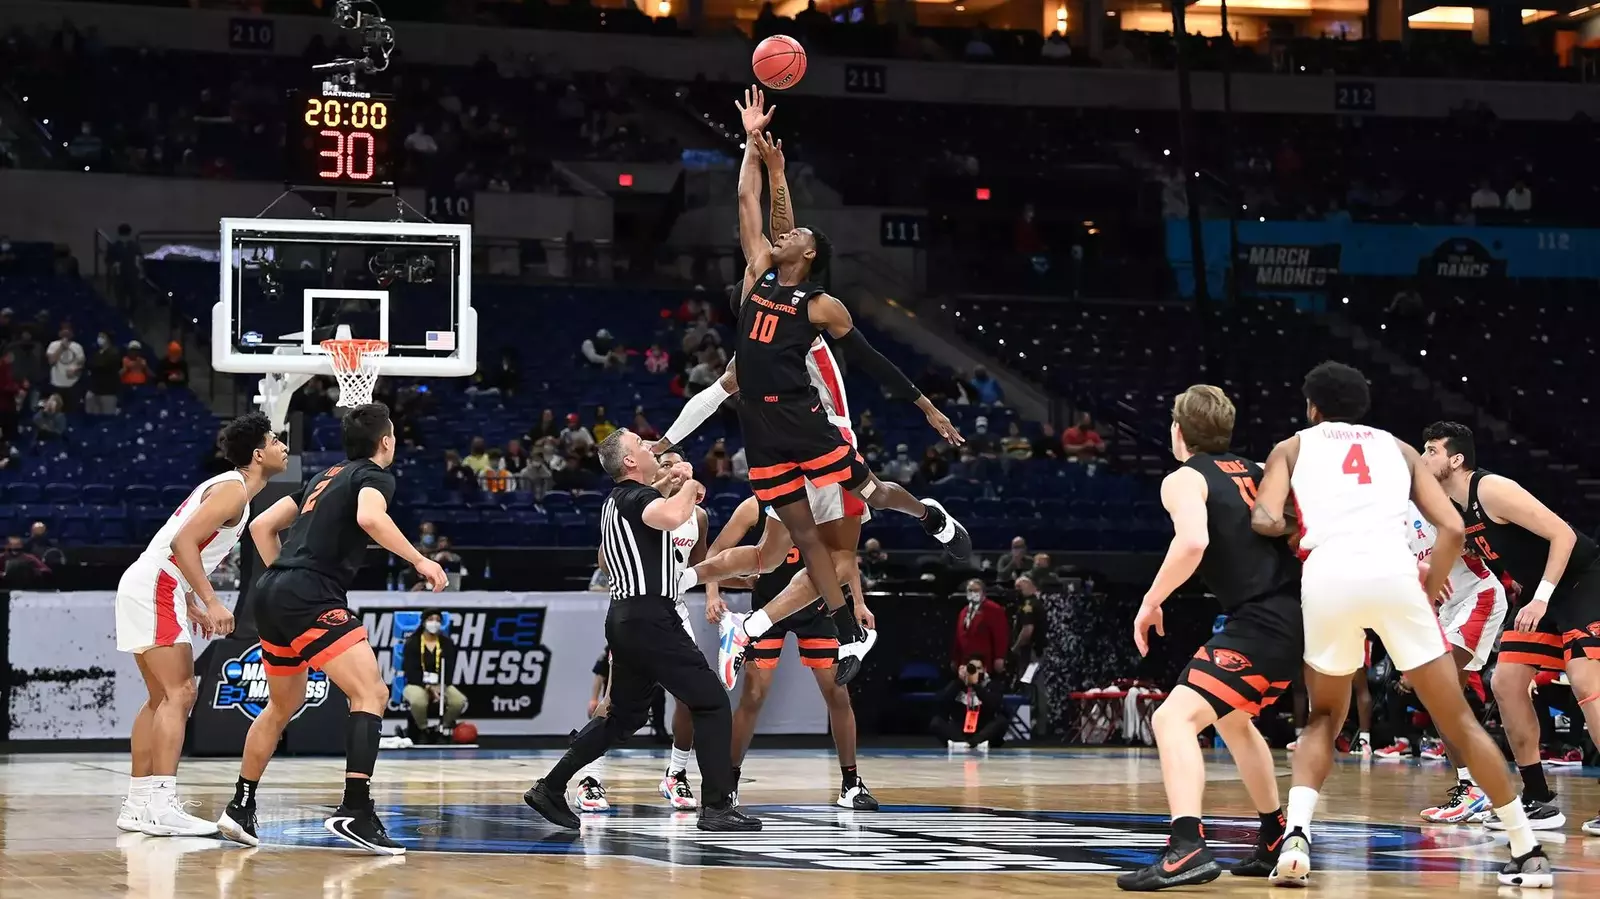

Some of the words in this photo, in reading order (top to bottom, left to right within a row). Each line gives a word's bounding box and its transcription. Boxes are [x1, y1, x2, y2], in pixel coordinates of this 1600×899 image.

[233, 25, 271, 43] 210
[848, 69, 881, 88] 211
[1339, 87, 1373, 105] 212
[305, 99, 387, 129] 20:00
[319, 130, 374, 179] 30
[430, 196, 469, 216] 110
[886, 221, 921, 241] 111
[1538, 231, 1570, 250] 112
[1249, 246, 1310, 265] MARCH
[774, 303, 797, 315] STATE
[749, 311, 779, 344] 10
[1342, 443, 1372, 485] 4
[301, 478, 332, 515] 2
[1474, 536, 1500, 560] 12
